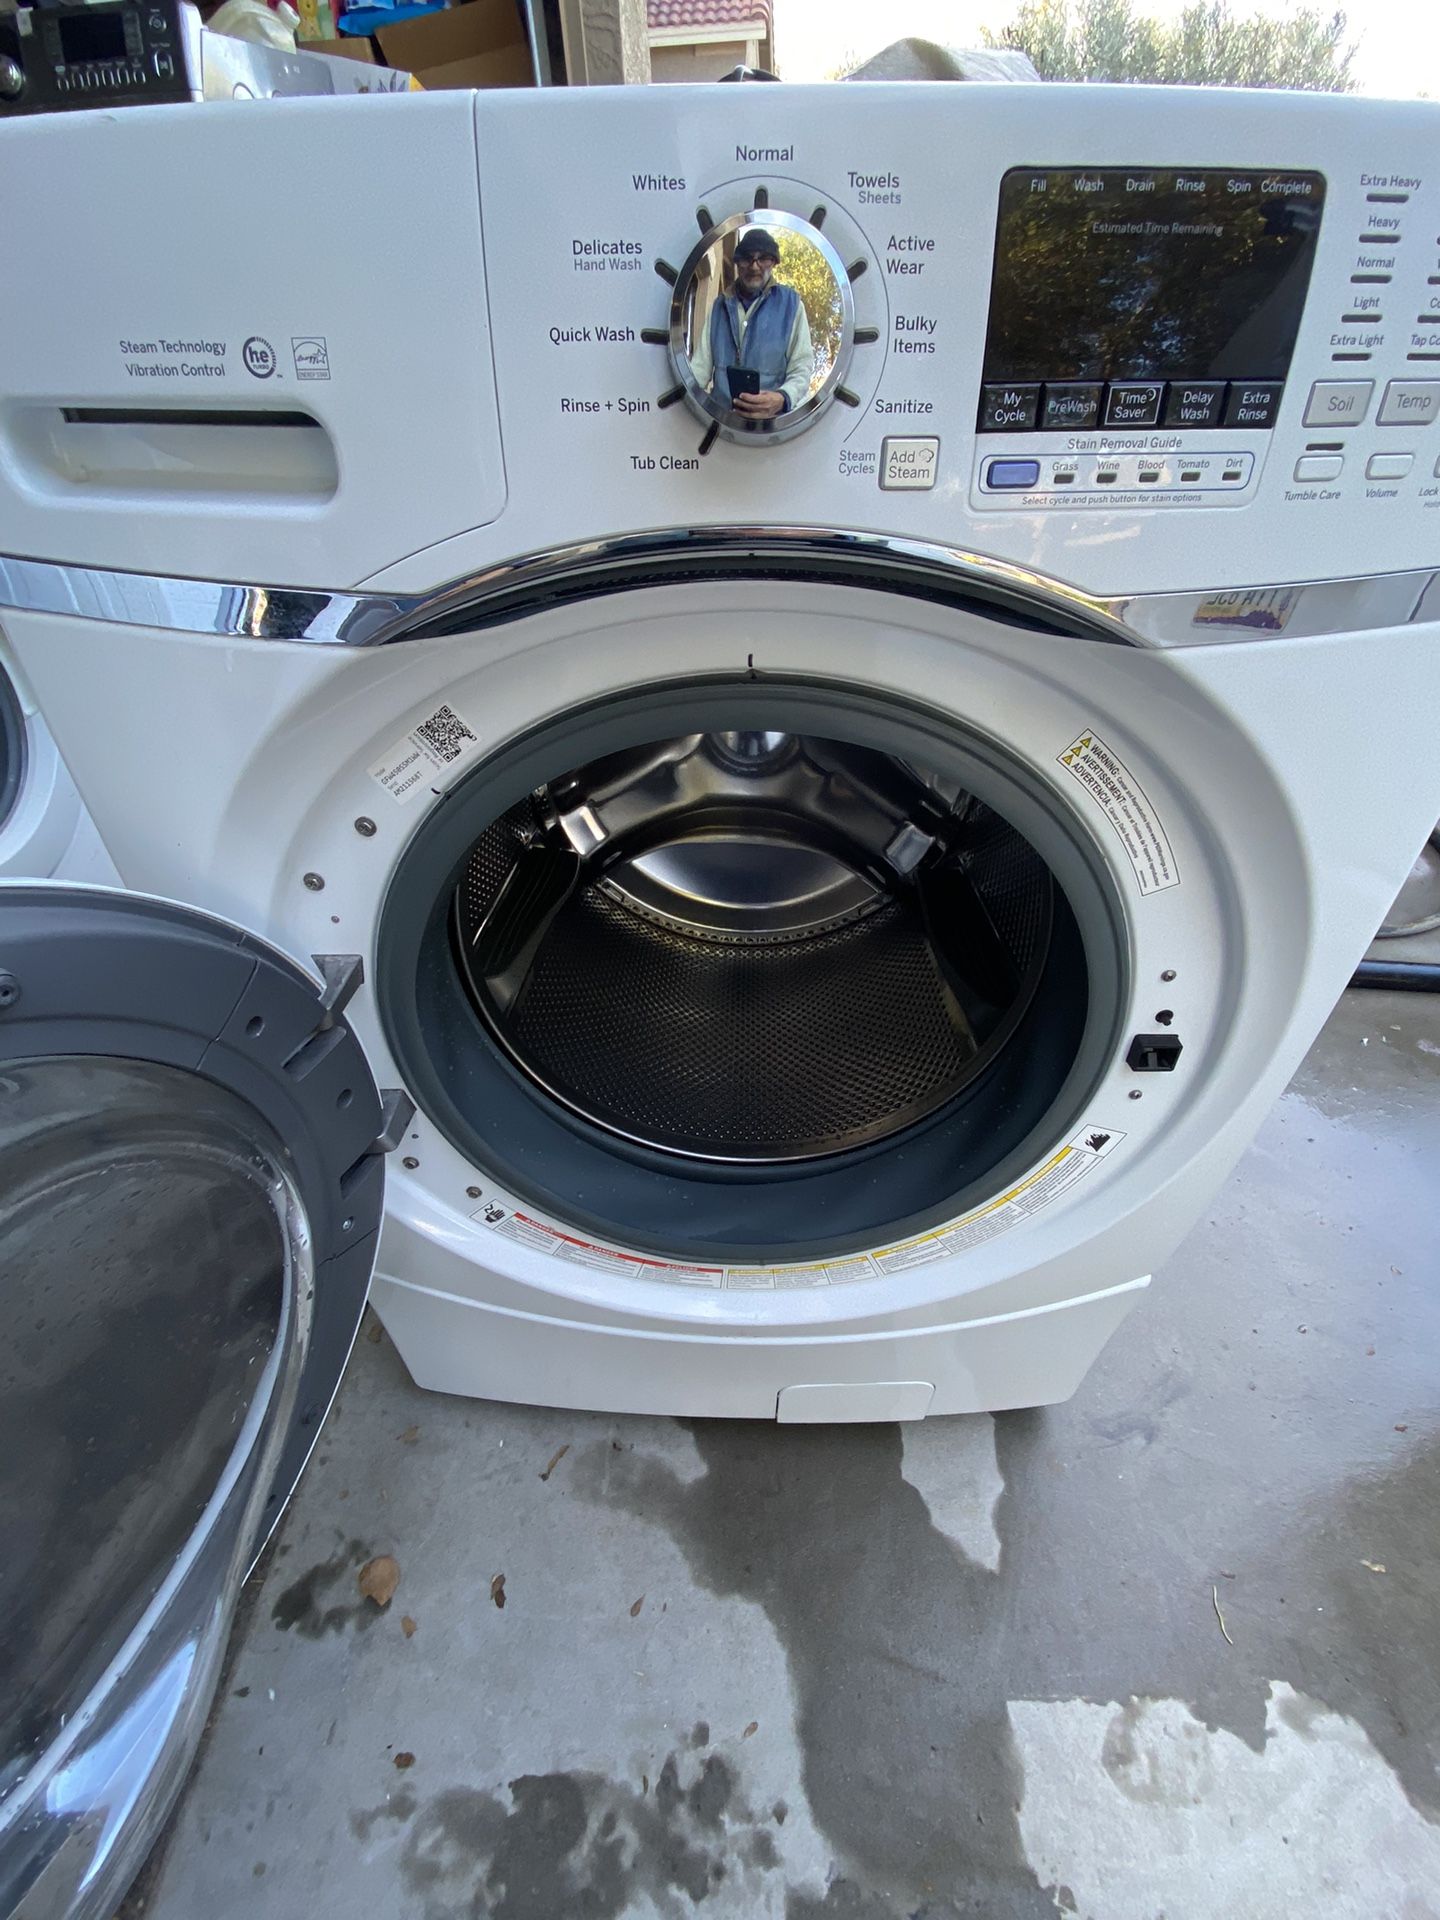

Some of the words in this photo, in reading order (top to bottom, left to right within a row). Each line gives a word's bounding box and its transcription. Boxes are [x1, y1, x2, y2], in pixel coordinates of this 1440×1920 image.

[735, 145, 794, 162] Normal
[632, 174, 687, 191] Whites
[847, 172, 900, 189] Towels
[1030, 178, 1047, 192] Fill
[1074, 178, 1104, 192] Wash
[1126, 178, 1155, 192] Drain
[1175, 178, 1206, 192] Rinse
[1227, 178, 1251, 194] Spin
[1261, 180, 1312, 196] Complete
[1360, 174, 1385, 187] Extra
[1388, 175, 1422, 190] Heavy
[858, 191, 902, 205] Sheets
[1092, 222, 1143, 234] Estimated
[1145, 222, 1169, 234] Time
[1171, 222, 1223, 237] Remaining
[1368, 216, 1400, 230] Heavy
[572, 239, 643, 255] Delicates
[887, 235, 935, 252] Active
[574, 258, 604, 271] Hand
[608, 258, 642, 271] Wash
[886, 258, 924, 275] Wear
[1356, 256, 1395, 268] Normal
[1353, 297, 1380, 309] Light
[895, 316, 938, 335] Bulky
[549, 327, 592, 344] Quick
[594, 326, 636, 342] Wash
[1330, 335, 1356, 346] Extra
[1359, 334, 1385, 348] Light
[1411, 334, 1427, 347] Tap
[119, 340, 158, 354] Steam
[158, 339, 227, 357] Technology
[893, 338, 936, 355] Items
[248, 346, 269, 363] he
[125, 363, 179, 377] Vibration
[181, 363, 226, 377] Control
[1003, 392, 1022, 407] My
[1119, 391, 1147, 404] Time
[1182, 391, 1214, 407] Delay
[1242, 391, 1270, 404] Extra
[1327, 396, 1353, 411] Soil
[1396, 393, 1432, 411] Temp
[561, 398, 600, 413] Rinse
[605, 400, 614, 411] +
[618, 397, 651, 415] Spin
[874, 399, 934, 415] Sanitize
[1048, 400, 1097, 413] PreWash
[1115, 406, 1146, 419] Saver
[1180, 407, 1209, 420] Wash
[994, 409, 1026, 425] Cycle
[1237, 408, 1267, 420] Rinse
[1067, 438, 1097, 450] Stain
[1099, 437, 1147, 449] Removal
[1150, 437, 1182, 448] Guide
[630, 456, 656, 471] Tub
[659, 455, 700, 470] Clean
[839, 450, 876, 463] Steam
[889, 450, 915, 463] Add
[838, 462, 875, 477] Cycles
[888, 465, 930, 479] Steam
[1052, 460, 1079, 471] Grass
[1097, 460, 1120, 470] Wine
[1137, 460, 1165, 470] Blood
[1177, 459, 1210, 469] Tomato
[1226, 458, 1243, 468] Dirt
[1284, 491, 1317, 501] Tumble
[1319, 490, 1341, 500] Care
[1365, 487, 1398, 498] Volume
[1418, 486, 1439, 497] Lock
[1022, 497, 1047, 505] Select
[1049, 497, 1070, 506] cycle
[1071, 496, 1087, 504] and
[1088, 496, 1108, 505] push
[1110, 494, 1136, 503] button
[1138, 494, 1149, 503] for
[1151, 493, 1171, 502] stain
[1172, 494, 1202, 503] options
[1090, 744, 1120, 777] WARNING:
[1072, 763, 1112, 808] ADVERTENCIA:
[1080, 753, 1126, 806] AVERTISSEMENT:
